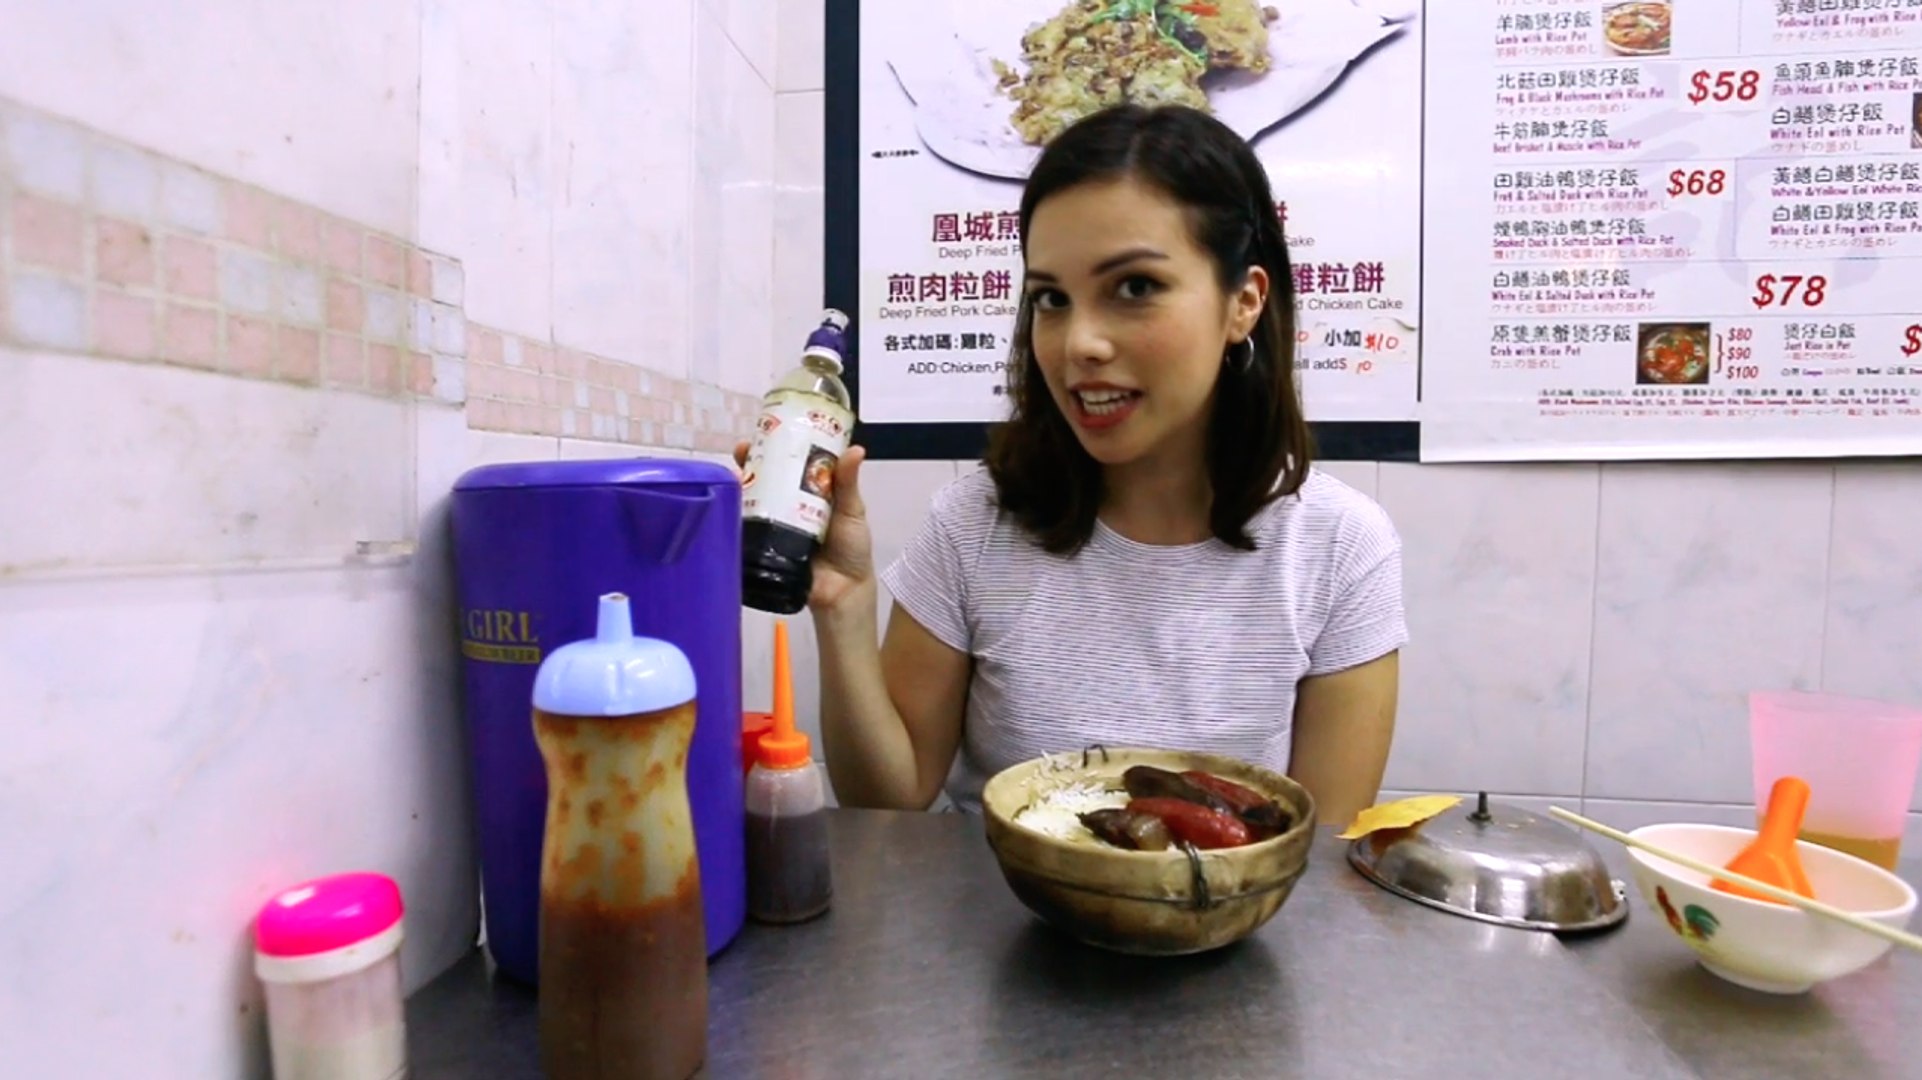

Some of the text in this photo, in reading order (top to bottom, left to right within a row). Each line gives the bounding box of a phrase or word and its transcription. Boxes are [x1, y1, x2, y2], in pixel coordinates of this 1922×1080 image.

[1844, 14, 1866, 27] Frog
[1868, 13, 1889, 23] with
[1894, 11, 1916, 21] Rice
[1495, 31, 1588, 45] Lamb with Rice Pot
[1605, 89, 1623, 100] with
[1627, 88, 1647, 99] Rice
[1650, 87, 1665, 98] Pot
[1687, 69, 1760, 106] $58
[1773, 84, 1793, 96] Fish
[1797, 83, 1822, 95] Head
[1837, 81, 1858, 93] Fish
[1863, 80, 1884, 91] with
[1889, 79, 1908, 90] Rice
[1770, 124, 1905, 140] White Eel with Rice Pot
[1587, 140, 1605, 150] with
[1607, 139, 1625, 149] Rice
[1628, 138, 1642, 148] Pot
[1666, 168, 1726, 198] $68
[1771, 186, 1802, 198] White
[1852, 184, 1868, 195] Eel
[1906, 182, 1922, 193] Ric
[1585, 188, 1604, 199] with
[1608, 188, 1629, 199] Rice
[1632, 187, 1649, 198] Pot
[1770, 225, 1799, 236] White
[1803, 224, 1820, 235] Eel
[1822, 224, 1830, 234] &
[1835, 223, 1856, 237] Frog
[1860, 222, 1880, 234] with
[1884, 222, 1907, 233] Rice
[1493, 238, 1525, 248] Smoked
[1616, 236, 1635, 246] with
[1638, 235, 1656, 245] Rice
[1659, 234, 1675, 245] Pot
[938, 247, 972, 260] Deep
[976, 245, 1007, 257] Fried
[887, 270, 1012, 303] 煎肉粒餅
[1752, 273, 1826, 309] $78
[1491, 290, 1516, 301] White
[1536, 290, 1542, 300] &
[1598, 289, 1615, 299] with
[1619, 288, 1637, 299] Rice
[1640, 288, 1655, 298] Pot
[879, 304, 1017, 319] Deep Fried Pork Cake
[1308, 298, 1363, 311] Chicken
[1367, 298, 1403, 310] Cake
[1325, 328, 1361, 347] 小加
[1727, 328, 1753, 341] $80
[1490, 345, 1581, 356] Crab with Rice Pot
[1727, 347, 1751, 360] $90
[1727, 365, 1759, 379] $100
[468, 609, 539, 642] GIRL
